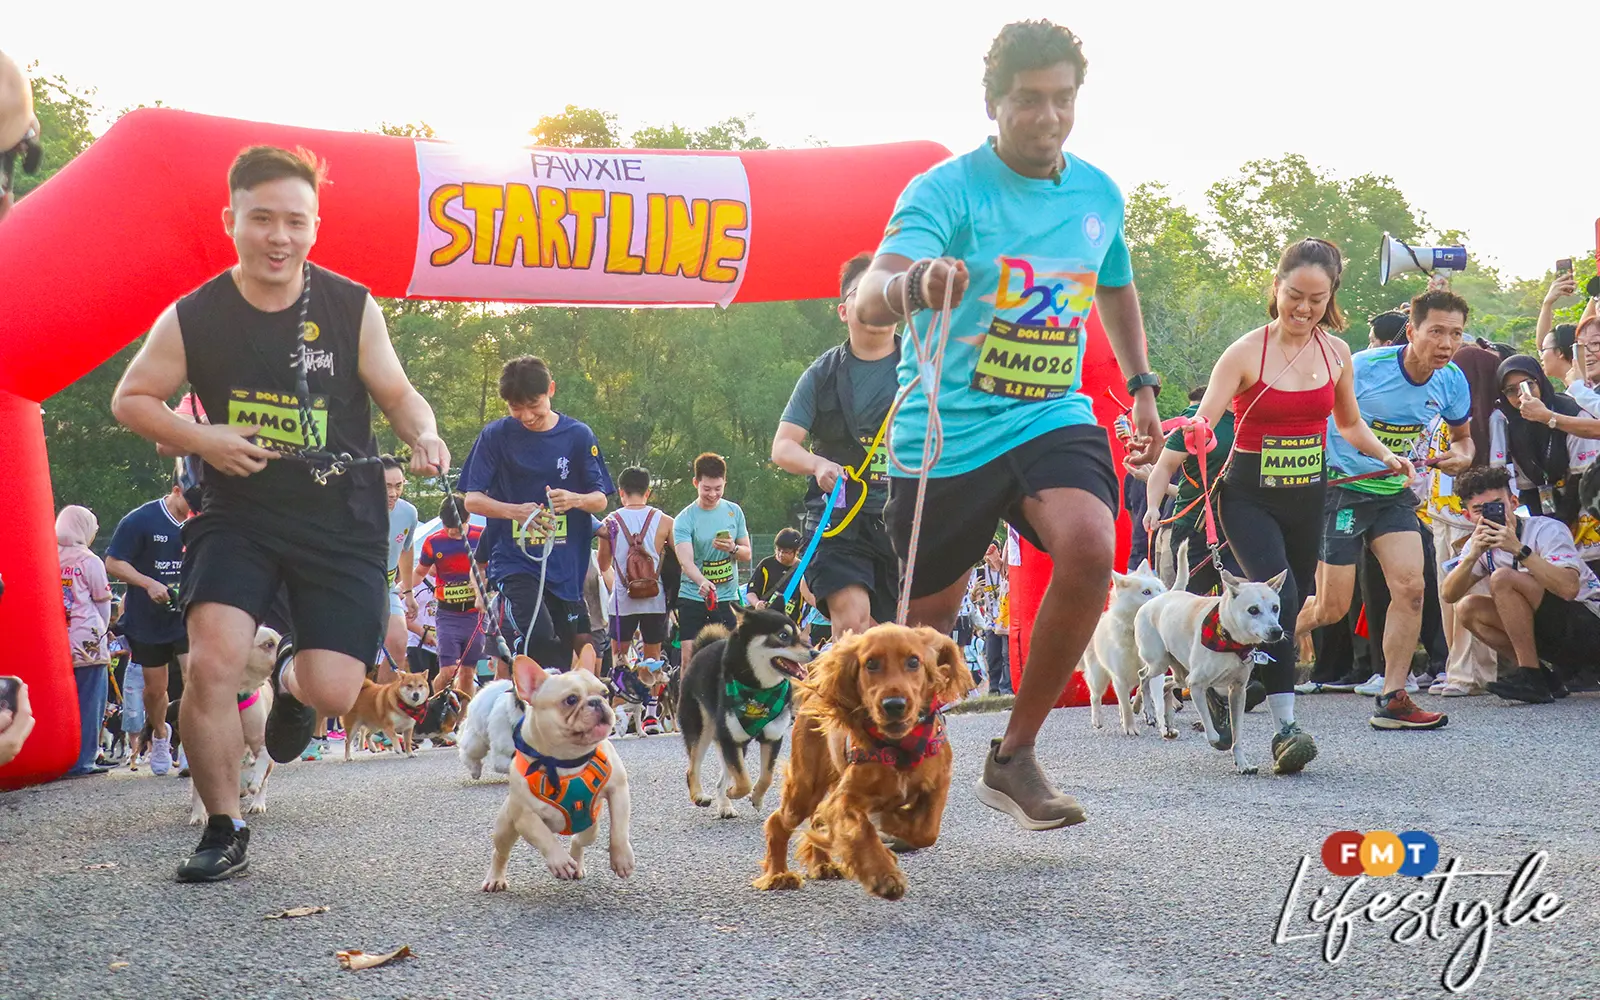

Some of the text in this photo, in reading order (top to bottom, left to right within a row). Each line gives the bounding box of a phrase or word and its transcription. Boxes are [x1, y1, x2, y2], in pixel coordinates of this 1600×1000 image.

[531, 153, 645, 182] PAWXIE
[1017, 328, 1066, 341] DOG RACE
[1005, 382, 1022, 395] 1.3
[1024, 386, 1046, 398] KM
[255, 391, 279, 403] DOG
[281, 395, 299, 405] RA
[1281, 439, 1298, 447] DOG
[1299, 437, 1315, 446] RACE
[1282, 477, 1294, 485] 1.3
[1296, 476, 1310, 485] KM
